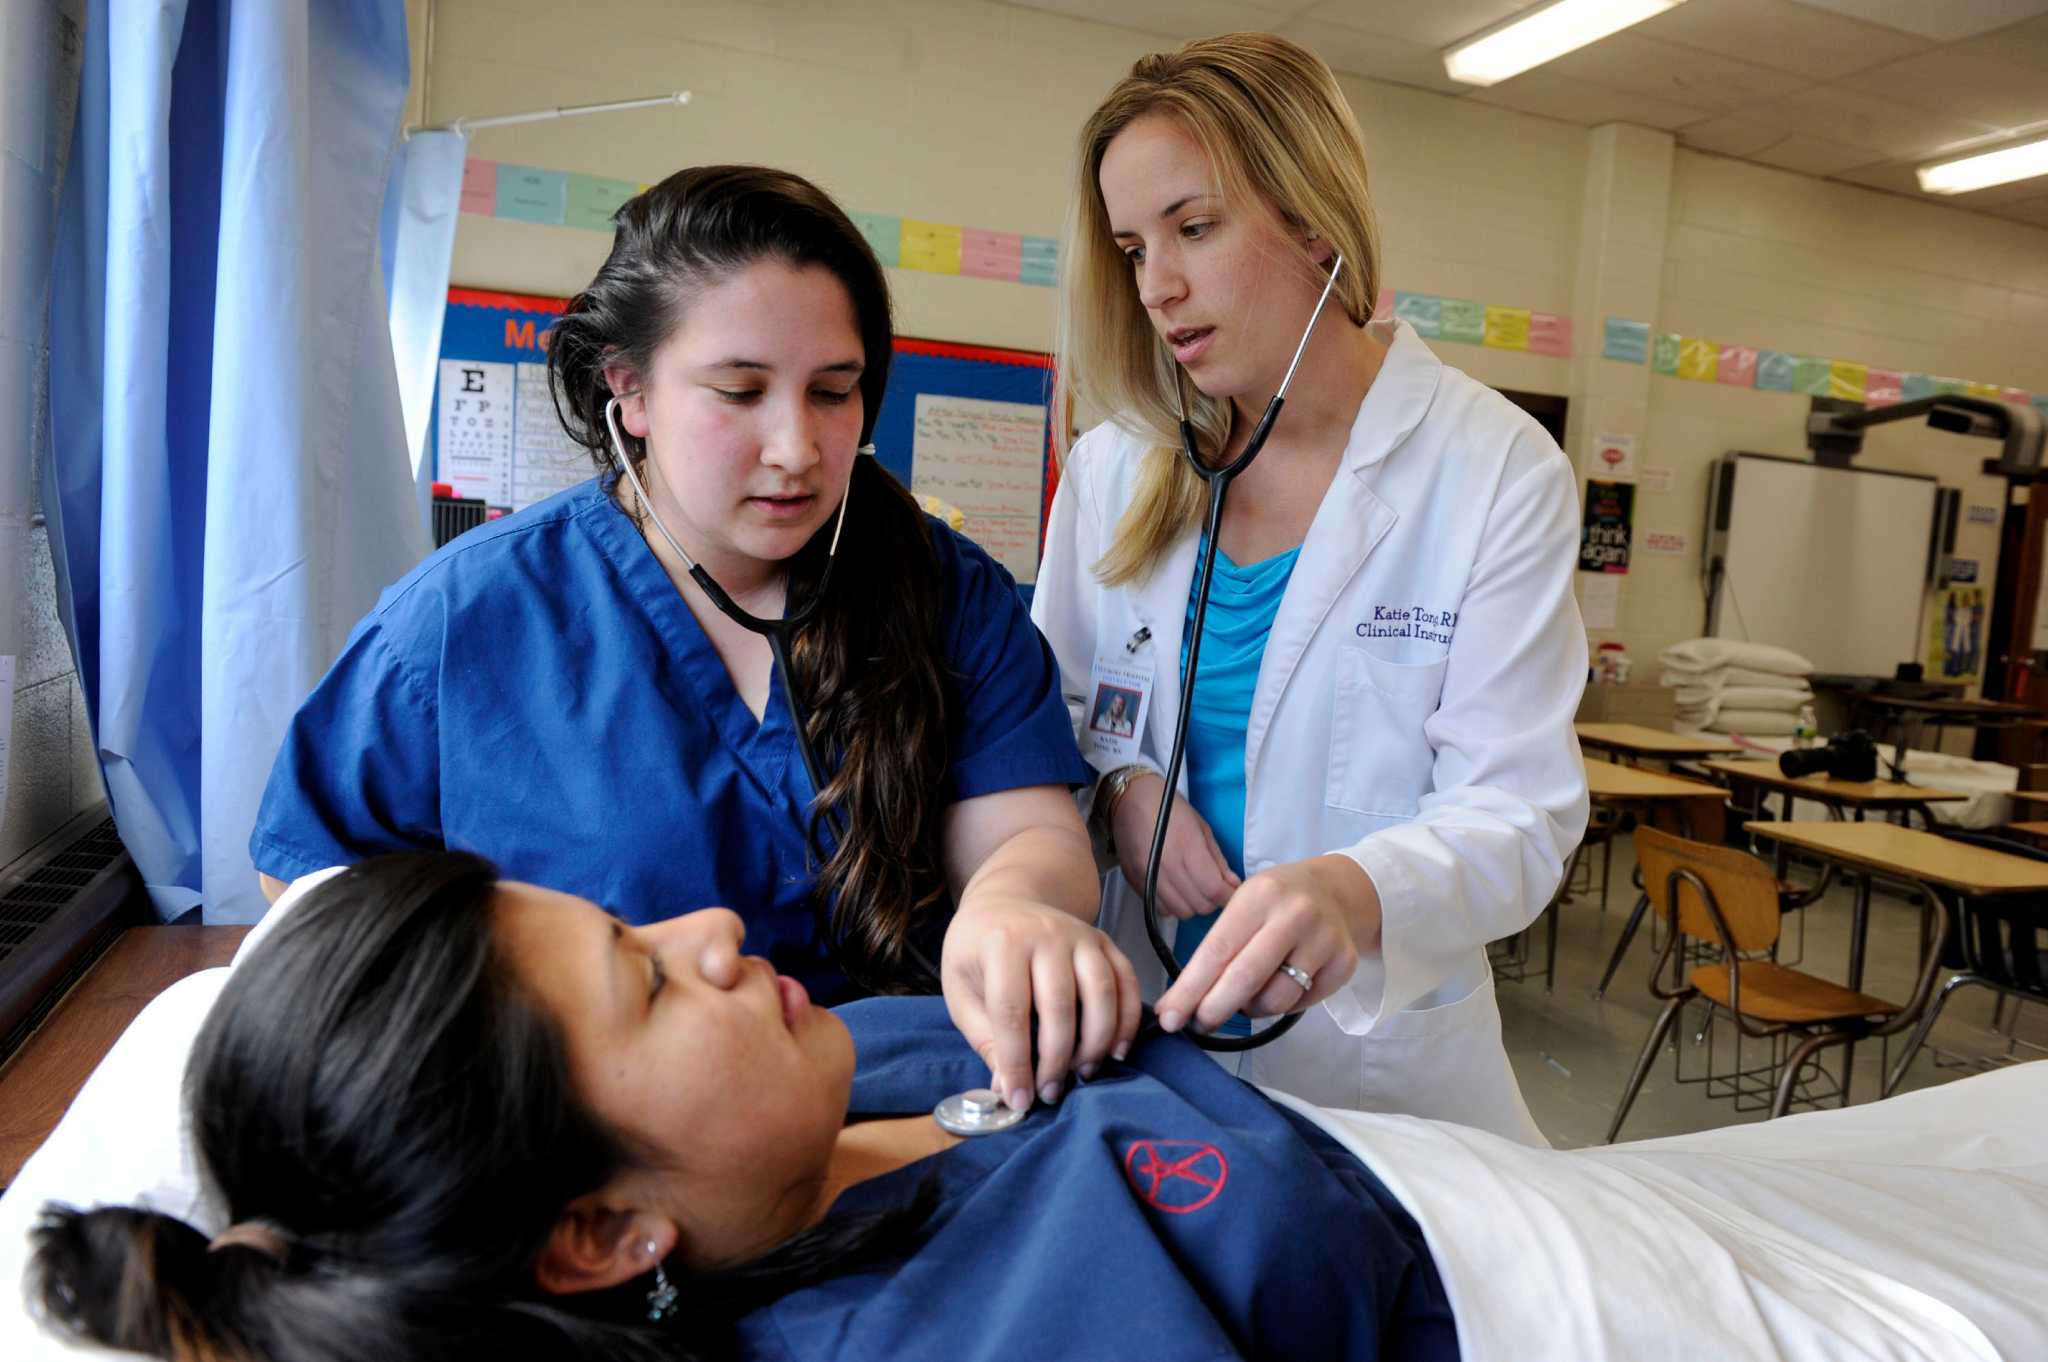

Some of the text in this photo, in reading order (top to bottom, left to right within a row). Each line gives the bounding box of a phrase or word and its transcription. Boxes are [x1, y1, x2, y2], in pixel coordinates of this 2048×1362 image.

[461, 369, 484, 393] E
[1374, 606, 1410, 620] Katie
[1356, 623, 1411, 637] Clinical
